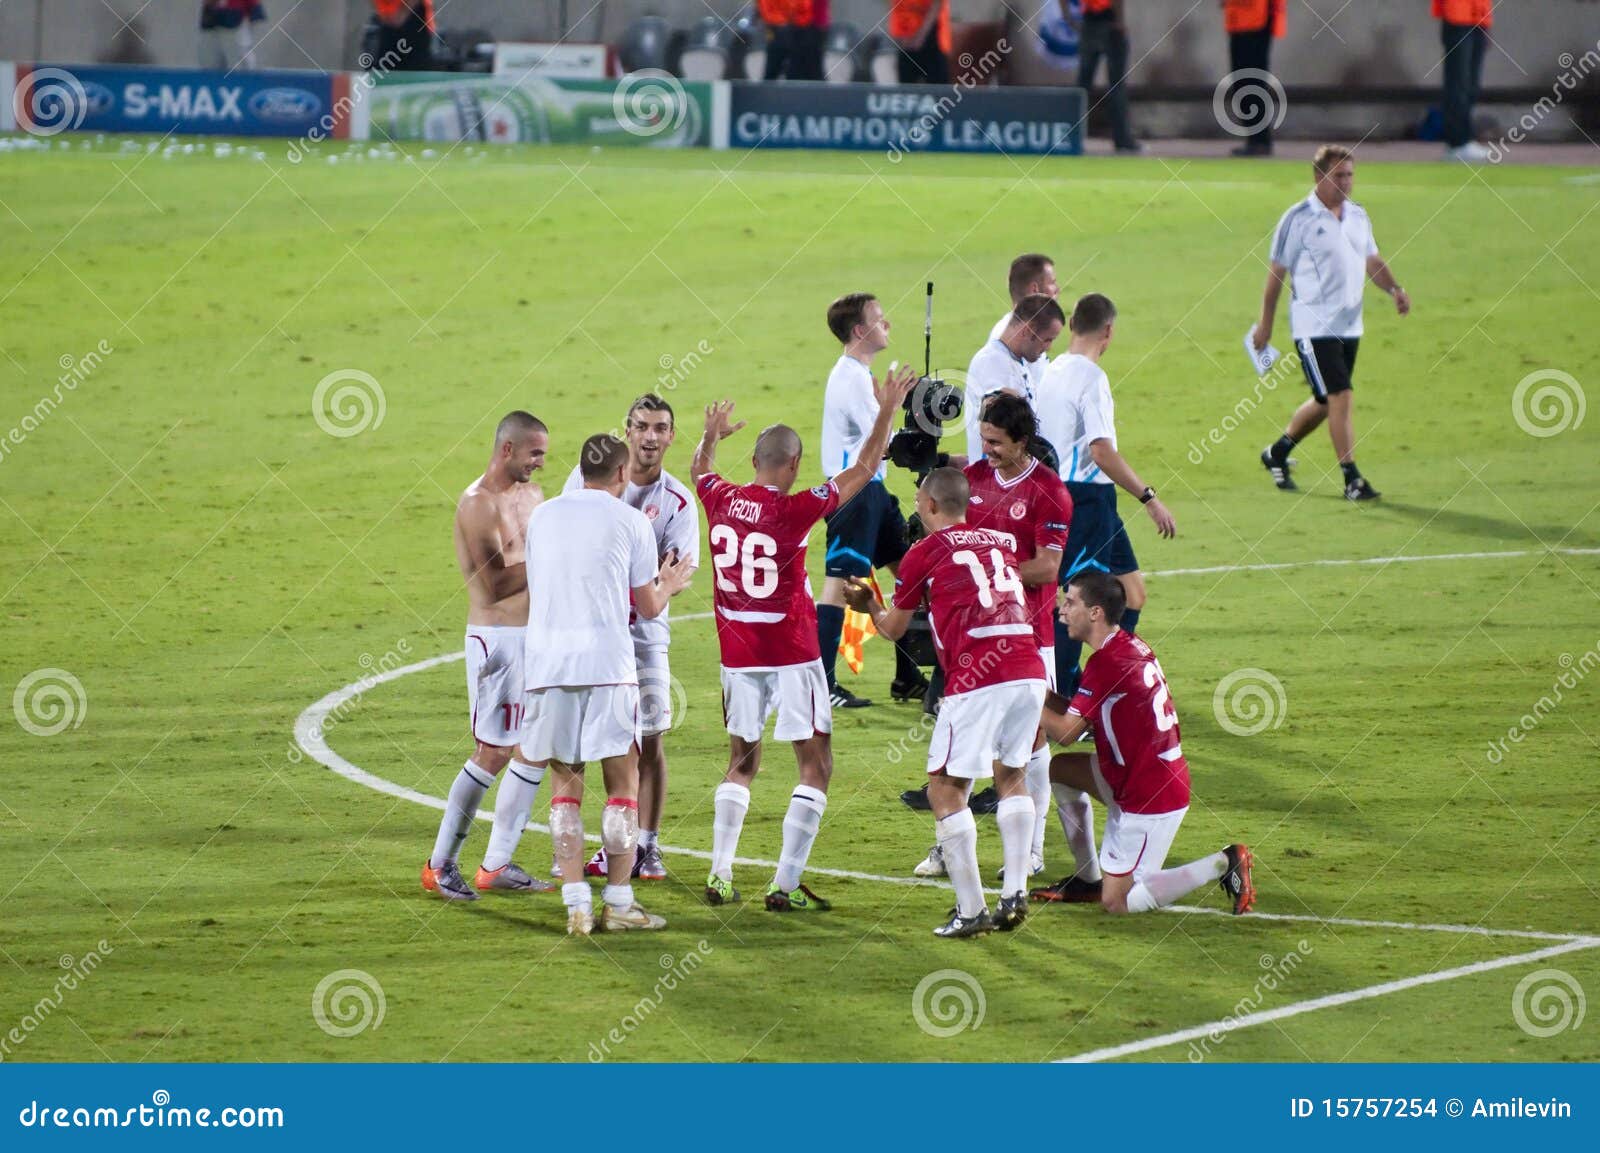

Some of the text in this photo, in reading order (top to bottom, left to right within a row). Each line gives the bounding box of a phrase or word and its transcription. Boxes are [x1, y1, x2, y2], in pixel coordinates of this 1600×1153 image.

[122, 83, 243, 120] S-MAX
[866, 92, 939, 114] UEFA
[735, 111, 1073, 150] CHAMPIONS LEAGUE
[727, 498, 763, 524] YADIN
[710, 523, 779, 599] 26
[952, 547, 1025, 609] 14
[1142, 657, 1179, 732] 2
